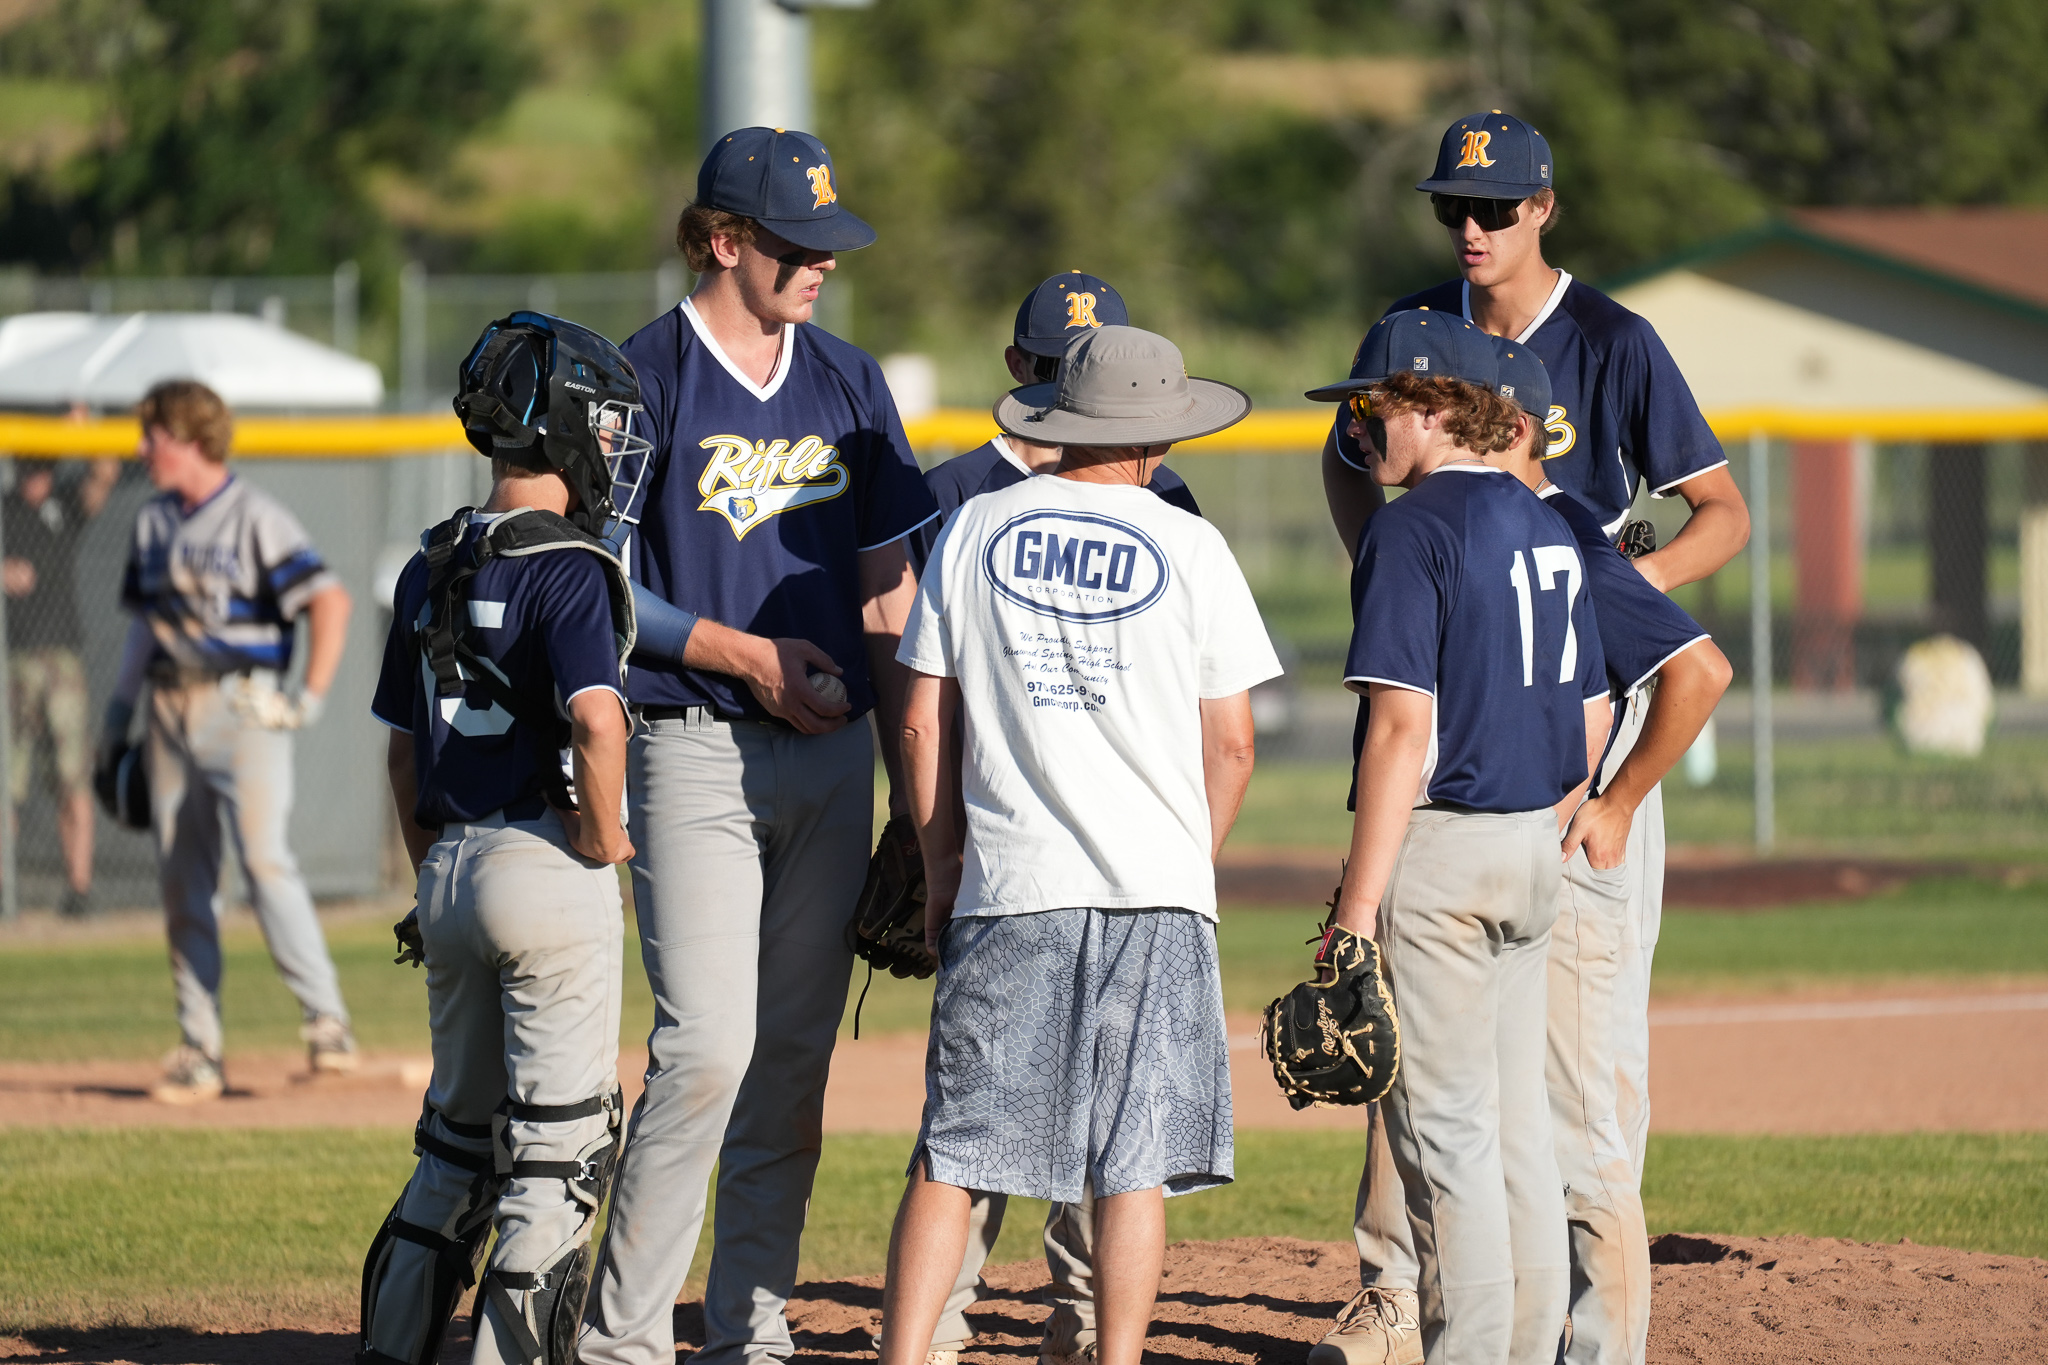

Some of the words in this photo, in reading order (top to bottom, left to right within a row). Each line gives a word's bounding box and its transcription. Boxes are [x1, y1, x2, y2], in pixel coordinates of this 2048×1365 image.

[1455, 130, 1497, 170] R
[806, 163, 837, 211] R
[1064, 290, 1103, 331] R
[564, 380, 597, 395] EASTON
[697, 433, 841, 500] Rifle
[1014, 531, 1137, 592] GMCO
[1027, 585, 1114, 604] CORPORATION
[1509, 545, 1583, 688] 17
[1019, 631, 1033, 642] We
[1073, 640, 1114, 654] Support
[1039, 662, 1058, 673] Our
[1078, 655, 1101, 669] High
[1103, 658, 1132, 671] School
[1316, 997, 1340, 1056] Rawlings
